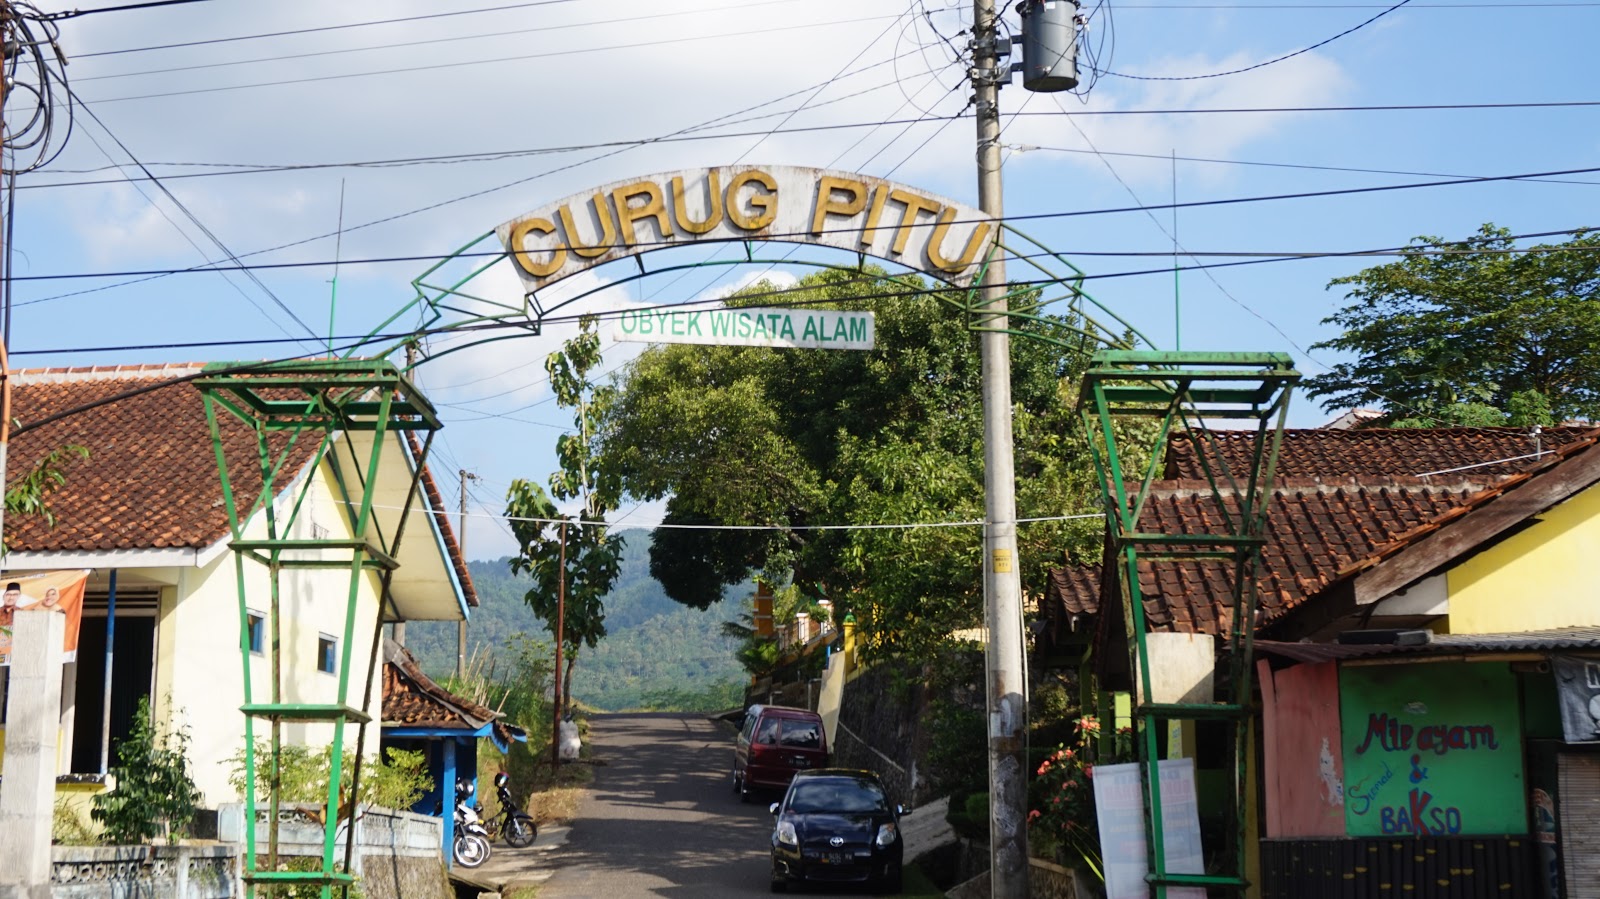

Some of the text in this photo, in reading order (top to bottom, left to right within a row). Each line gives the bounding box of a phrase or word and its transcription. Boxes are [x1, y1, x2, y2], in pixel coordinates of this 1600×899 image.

[509, 169, 993, 279] CURUG PITU
[620, 309, 866, 342] OBYEK WISATA ALAM
[1409, 754, 1428, 784] &
[1380, 787, 1462, 836] BAKSO
